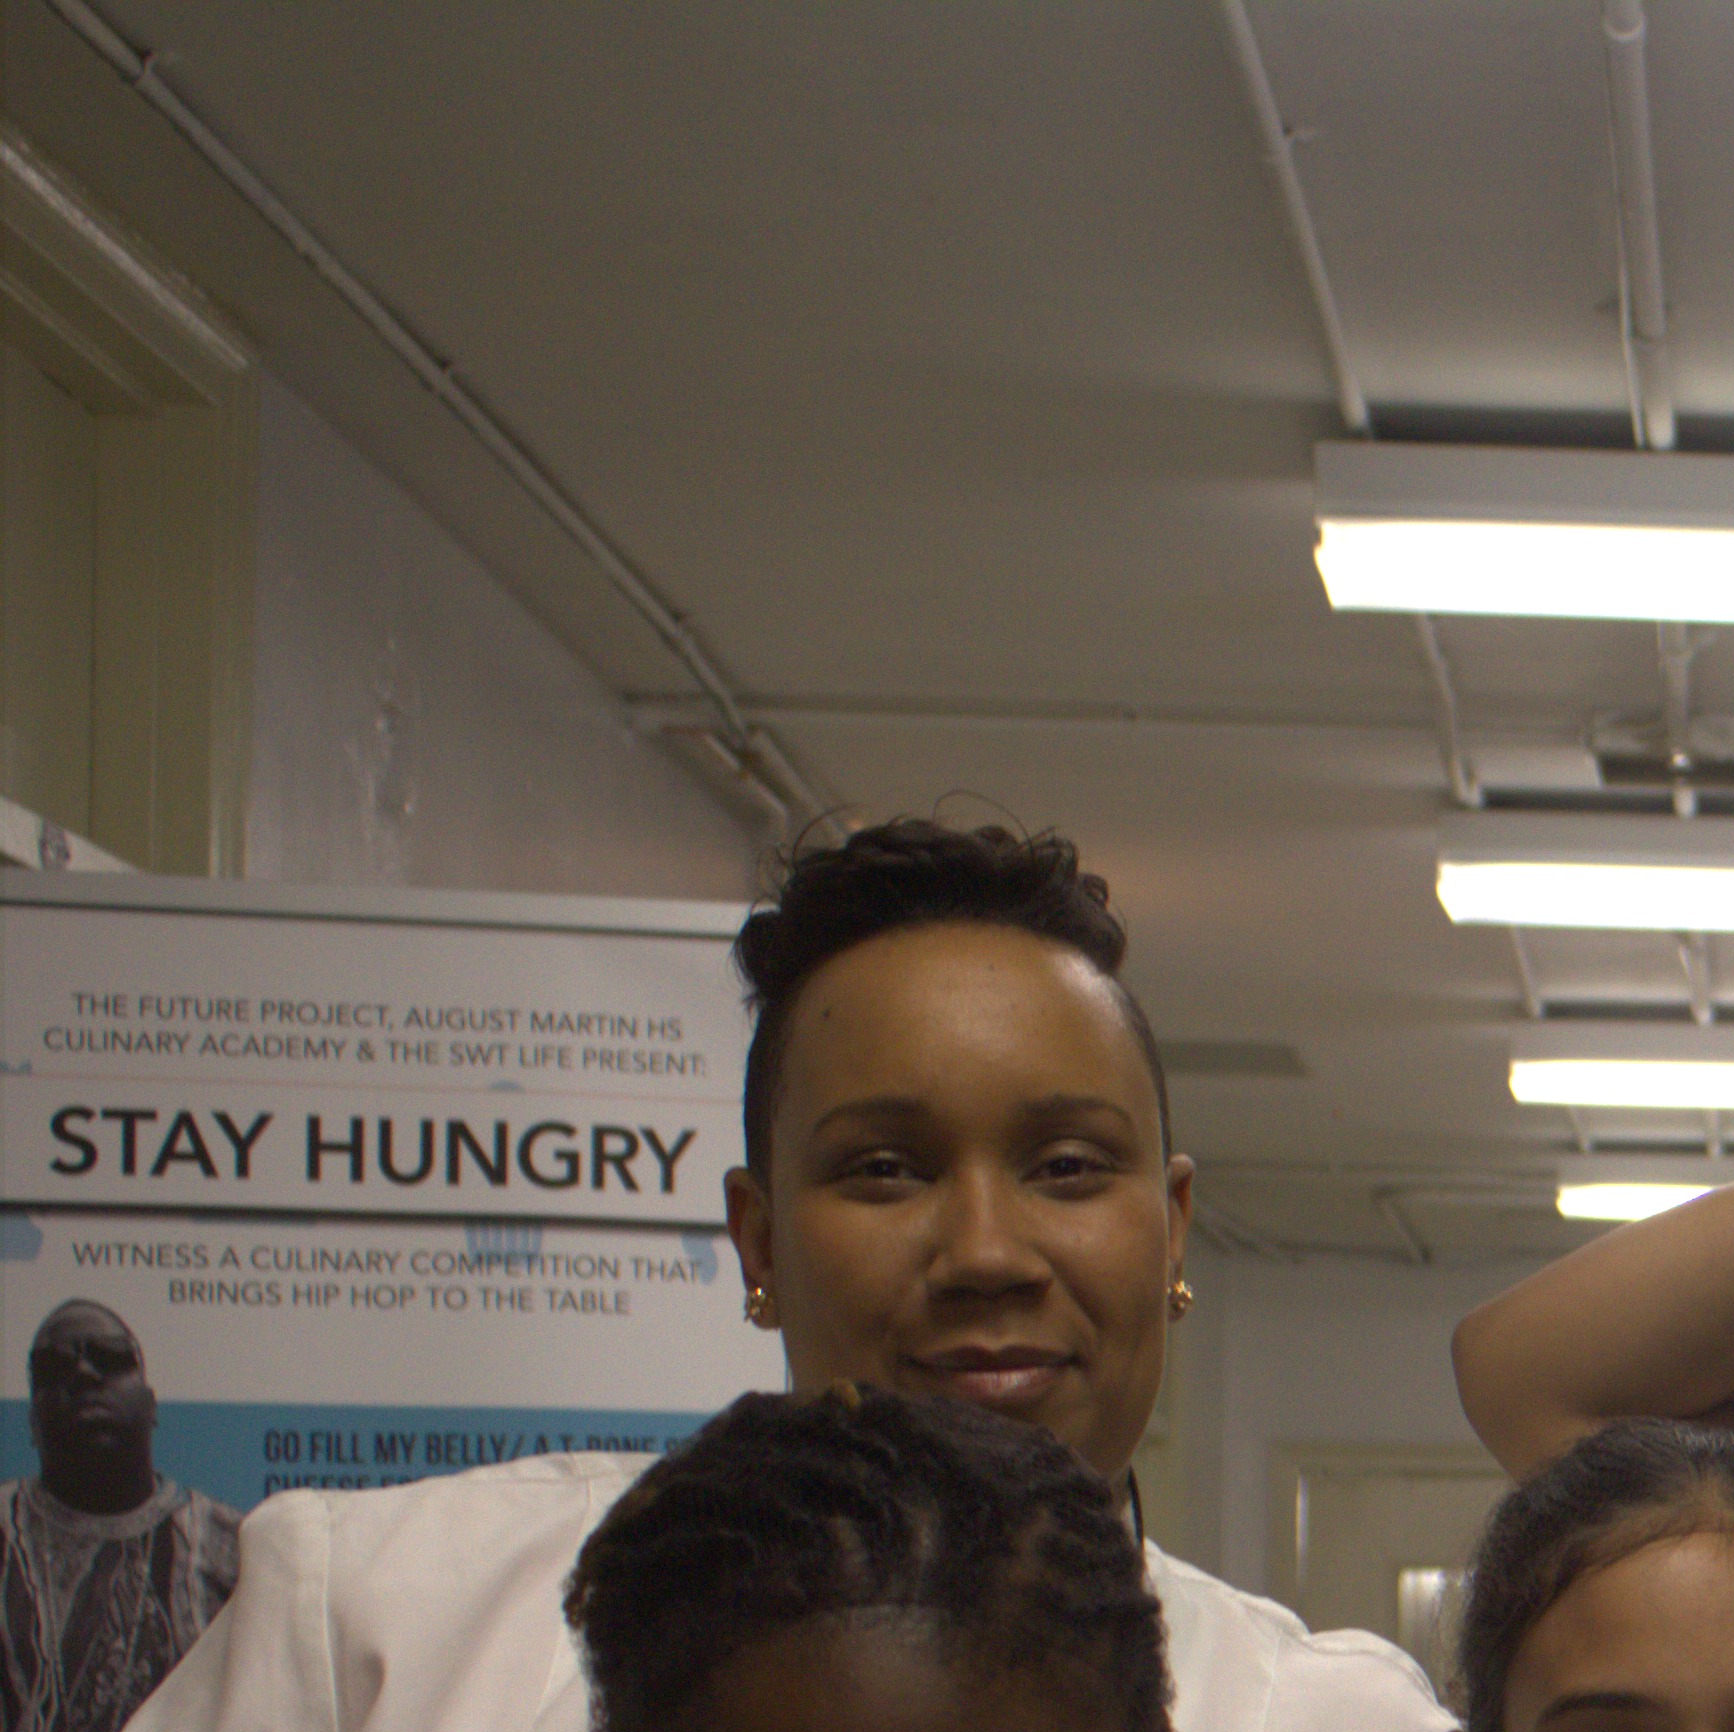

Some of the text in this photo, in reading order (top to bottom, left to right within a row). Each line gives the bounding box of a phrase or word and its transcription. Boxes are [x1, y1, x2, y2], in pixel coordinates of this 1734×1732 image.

[72, 992, 684, 1043] THE FUTURE PROJECT, AUGUST MARTIN HS
[43, 1026, 707, 1077] CULINARY ACADEMY & THE SWT LIFE PRESENT:
[49, 1104, 698, 1195] STAY HUNGRY
[71, 1242, 703, 1284] WITNESS A CULINARY COMPETITION THAT
[168, 1278, 633, 1317] BRINGS HIP HOP TO THE TABLE
[264, 1429, 300, 1464] GO
[308, 1431, 366, 1465] FILL
[374, 1431, 417, 1465] MY
